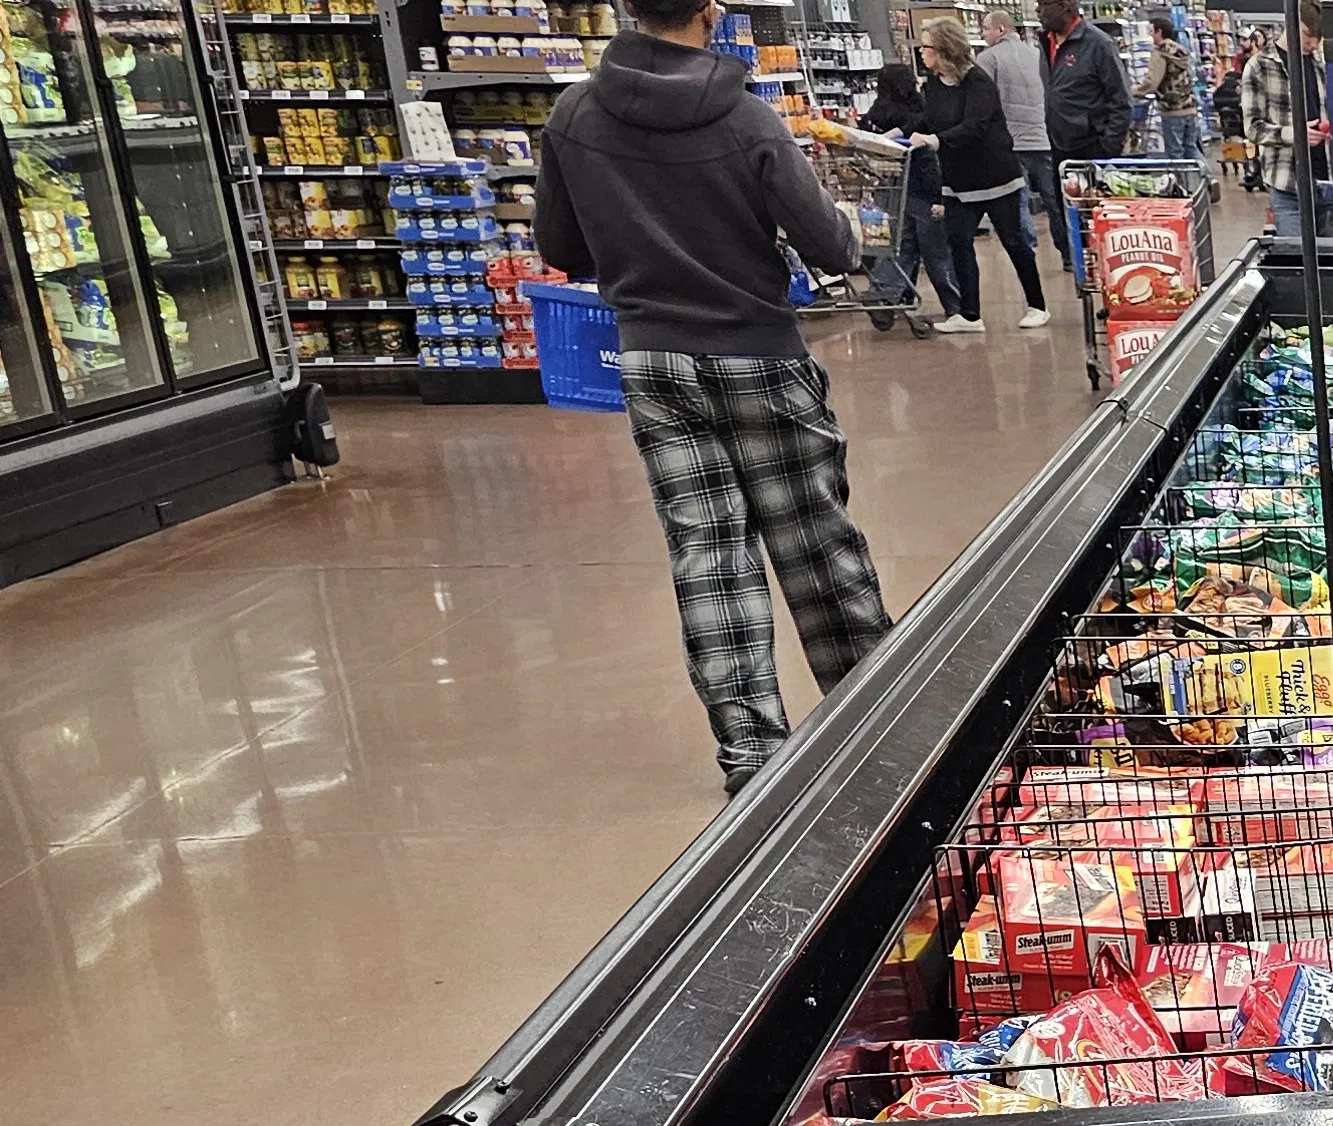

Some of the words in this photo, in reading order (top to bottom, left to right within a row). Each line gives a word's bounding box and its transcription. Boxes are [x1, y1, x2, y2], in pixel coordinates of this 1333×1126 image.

[1111, 231, 1172, 253] LouAna
[1121, 252, 1149, 263] PEANUT
[1152, 252, 1165, 262] OIL
[1121, 334, 1160, 355] LouA
[1276, 671, 1297, 715] Fluff
[1291, 660, 1308, 703] Thick
[1319, 675, 1333, 708] Eggo
